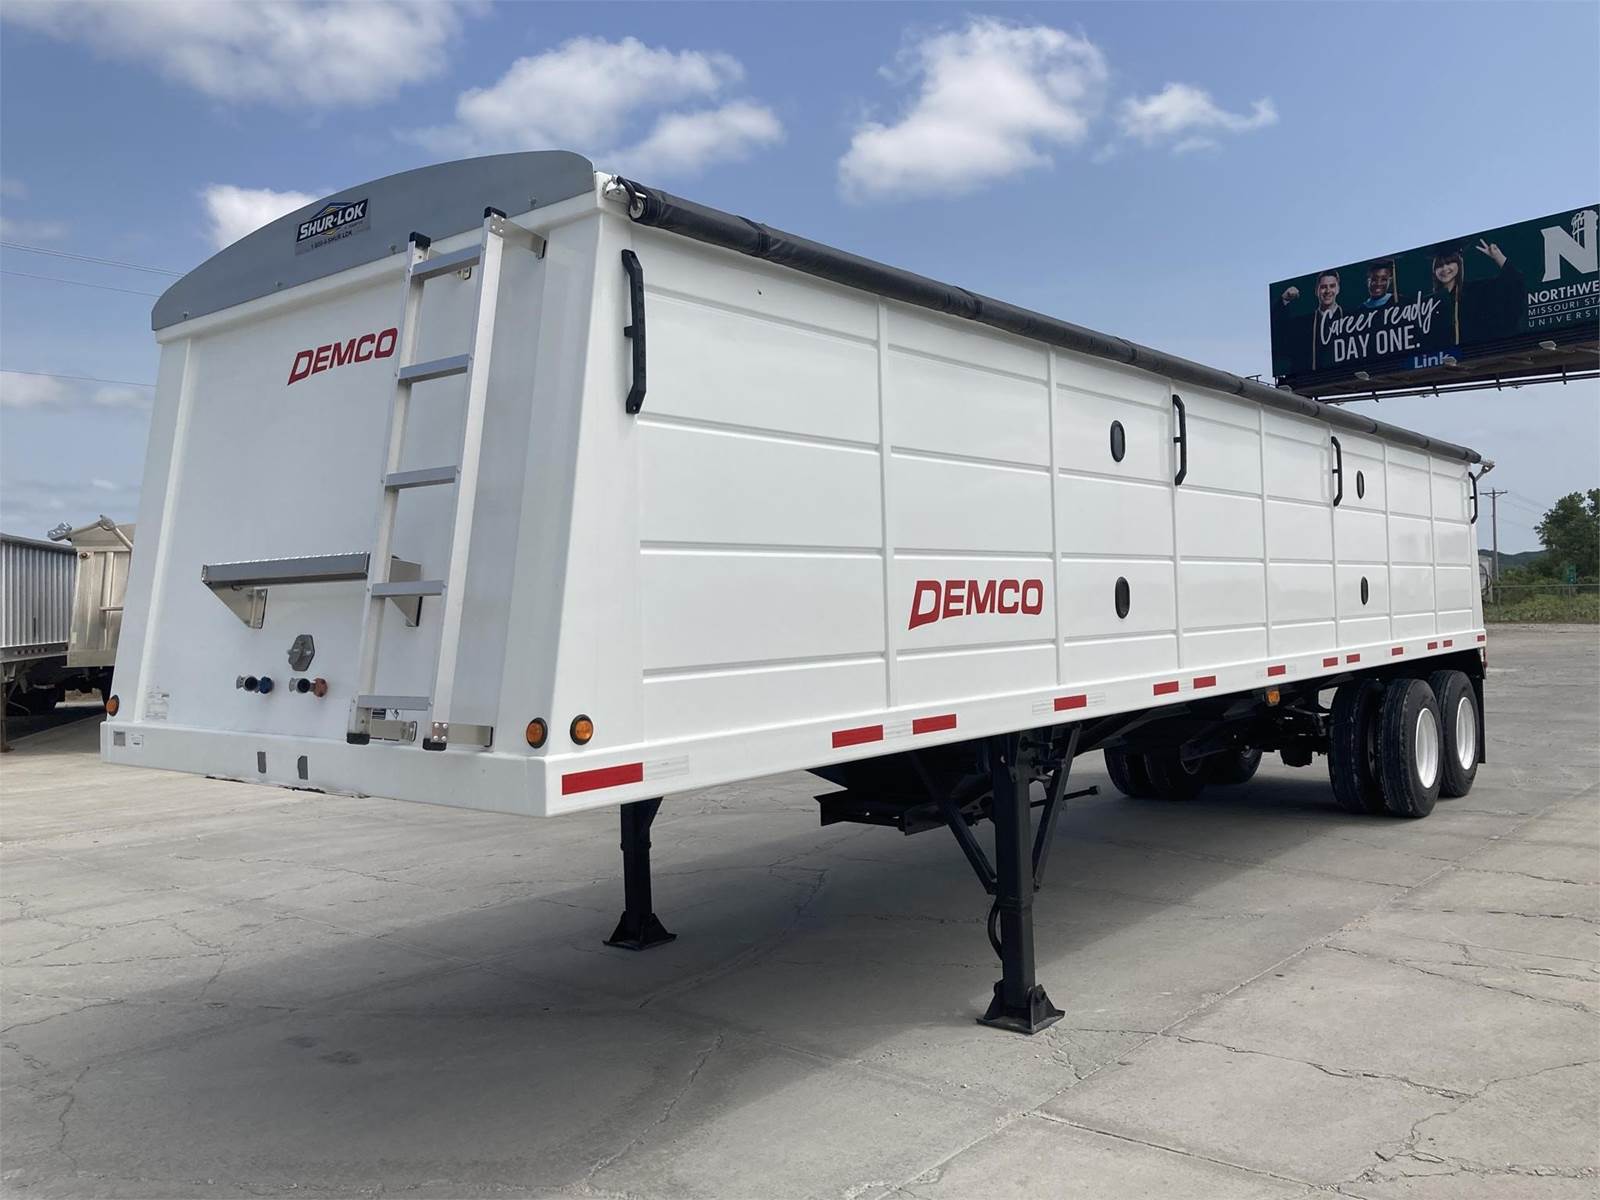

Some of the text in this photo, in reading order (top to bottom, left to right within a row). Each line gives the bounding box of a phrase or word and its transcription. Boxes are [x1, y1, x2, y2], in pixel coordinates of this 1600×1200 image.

[1320, 290, 1441, 345] Career ready.
[1528, 301, 1579, 316] MISSOURI
[287, 327, 398, 386] DEMCO
[1334, 324, 1420, 362] DAY ONE.
[908, 579, 1044, 631] DEMCO
